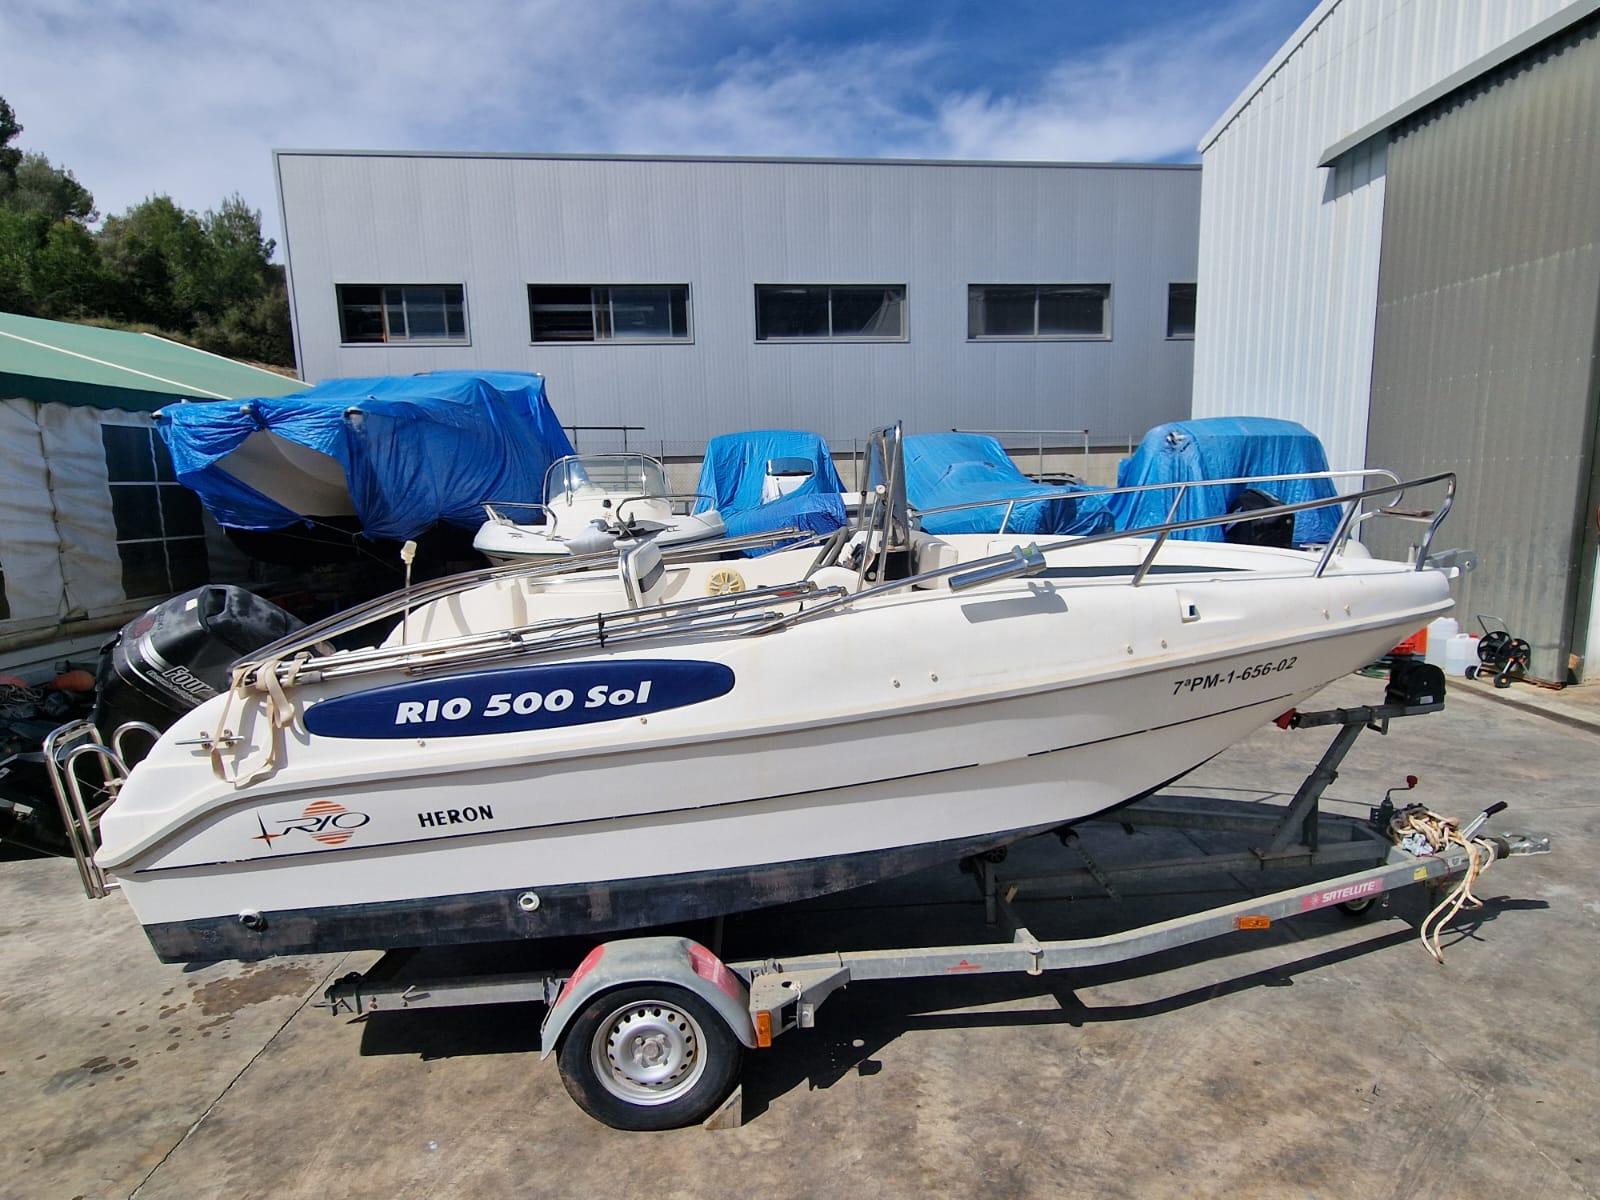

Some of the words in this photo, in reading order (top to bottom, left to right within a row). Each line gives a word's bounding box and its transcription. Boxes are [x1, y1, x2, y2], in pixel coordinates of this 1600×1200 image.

[394, 697, 472, 725] RIO
[483, 689, 575, 717] 500
[584, 680, 652, 708] Sol
[276, 811, 370, 836] RIO
[418, 805, 494, 828] HERON
[1322, 881, 1377, 903] SATELLITE
